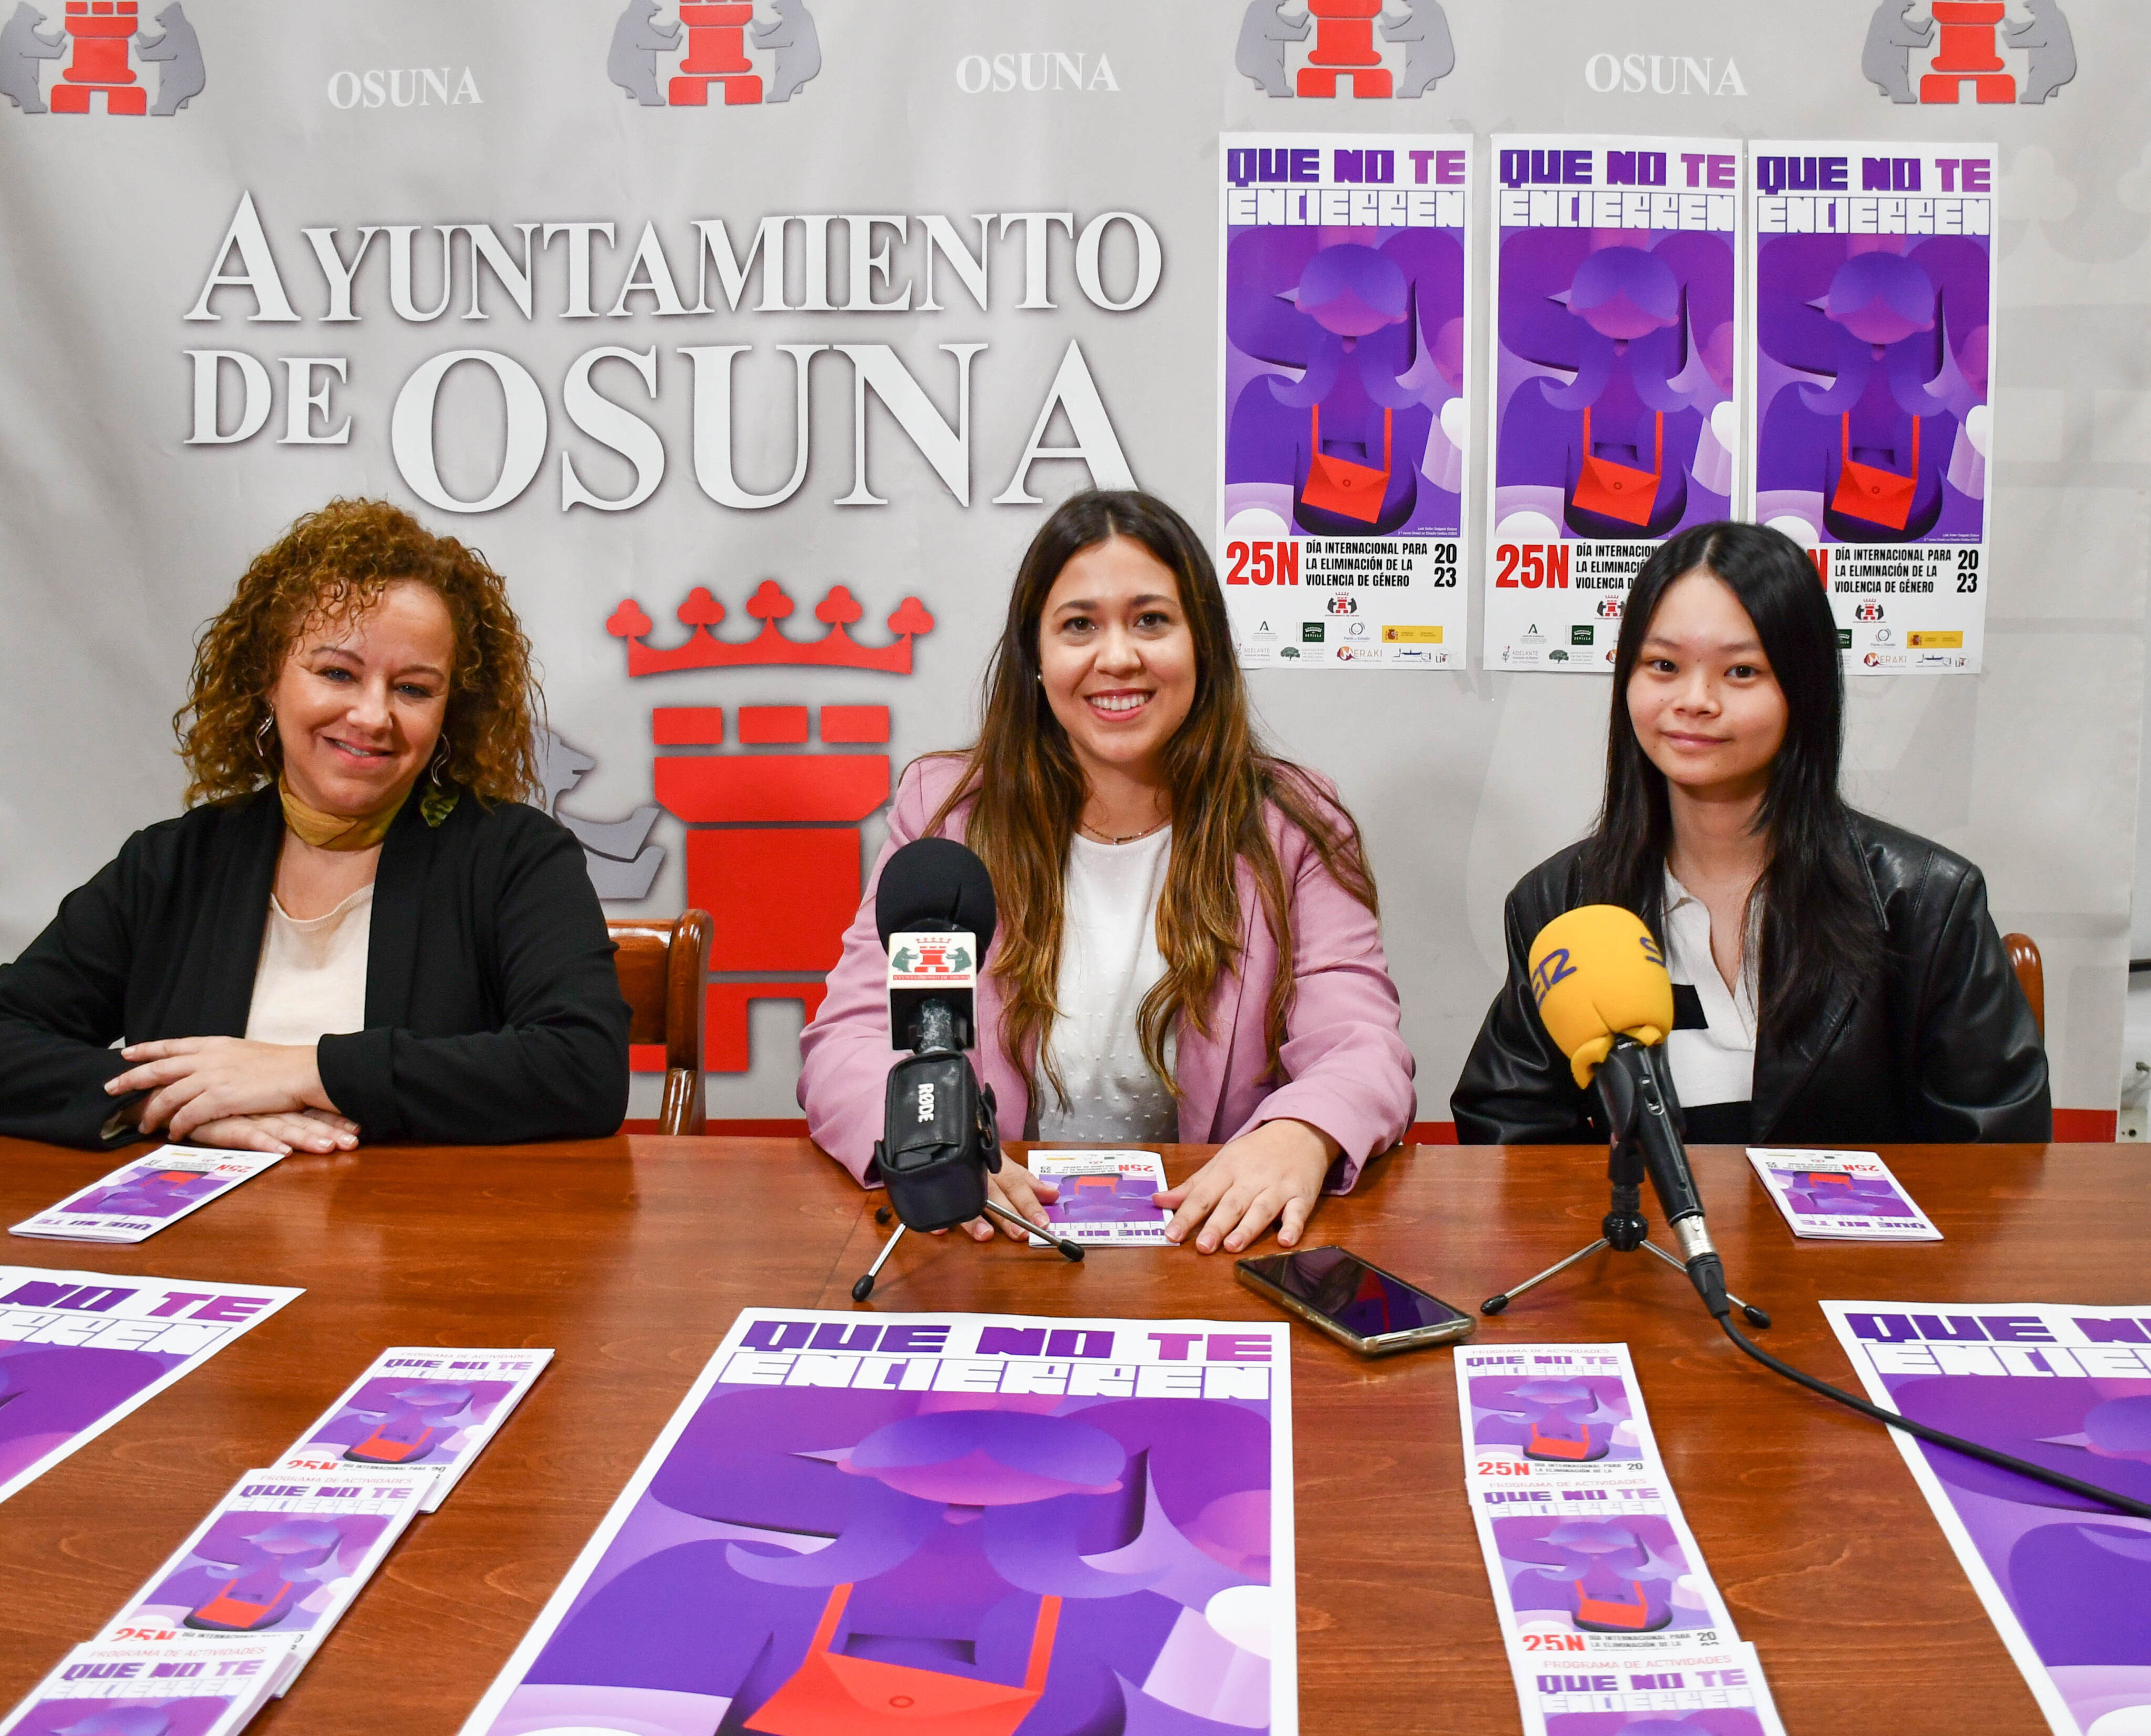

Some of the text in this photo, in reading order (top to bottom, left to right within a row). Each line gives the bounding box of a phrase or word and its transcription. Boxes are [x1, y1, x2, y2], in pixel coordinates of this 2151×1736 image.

[955, 52, 1121, 93] OSUNA
[1585, 53, 1748, 96] OSUNA
[327, 67, 483, 109] OSUNA
[1228, 148, 1465, 187] QUE NO TE
[1500, 150, 1735, 188] QUE NO TE
[1757, 156, 1990, 195] QUE NO TE
[183, 191, 1161, 323] AYUNTAMIENTO
[183, 339, 1141, 513] DE OSUNA
[1306, 541, 1427, 555] DÍA INTERNACIONAL PARA
[1435, 543, 1457, 564] 20
[1577, 542, 1591, 556] DÍA
[1835, 546, 1951, 561] DÍA INTERNACIONAL PARA
[1227, 541, 1298, 585] 25N
[1306, 556, 1412, 571] LA ELIMINACIÓN DE LA
[1496, 544, 1569, 588] 25N
[1576, 561, 1587, 573] LA
[1835, 563, 1937, 577] LA ELIMINACIÓN DE LA
[1958, 550, 1978, 570] 20
[1306, 572, 1409, 587] VIOLENCIA DE GÉNERO
[1434, 567, 1456, 587] 23
[1576, 577, 1624, 589] VIOLENCIA
[1835, 578, 1934, 593] VIOLENCIA DE GÉNERO
[1957, 573, 1977, 593] 23
[918, 1083, 934, 1123] RØDE
[0, 1281, 275, 1322] NO TE
[1844, 1313, 2058, 1343] QUE
[741, 1321, 1272, 1362] QUE NO TE
[384, 1359, 444, 1368] QUE
[497, 1362, 534, 1370] TE
[1466, 1356, 1525, 1366] QUE
[1534, 1356, 1572, 1364] NO
[1477, 1462, 1530, 1475] 25N
[239, 1485, 414, 1499] QUE NO TE
[1483, 1488, 1660, 1504] QUE NO TE
[1522, 1634, 1585, 1651] 25N
[1697, 1632, 1717, 1641] 20
[89, 1650, 160, 1658] PROGRAMA
[185, 1647, 267, 1657] ACTIVIDADES
[1646, 1655, 1732, 1668] ACTIVIDADES
[61, 1659, 266, 1681] QUE NO TE
[1537, 1669, 1748, 1694] QUE NO TE
